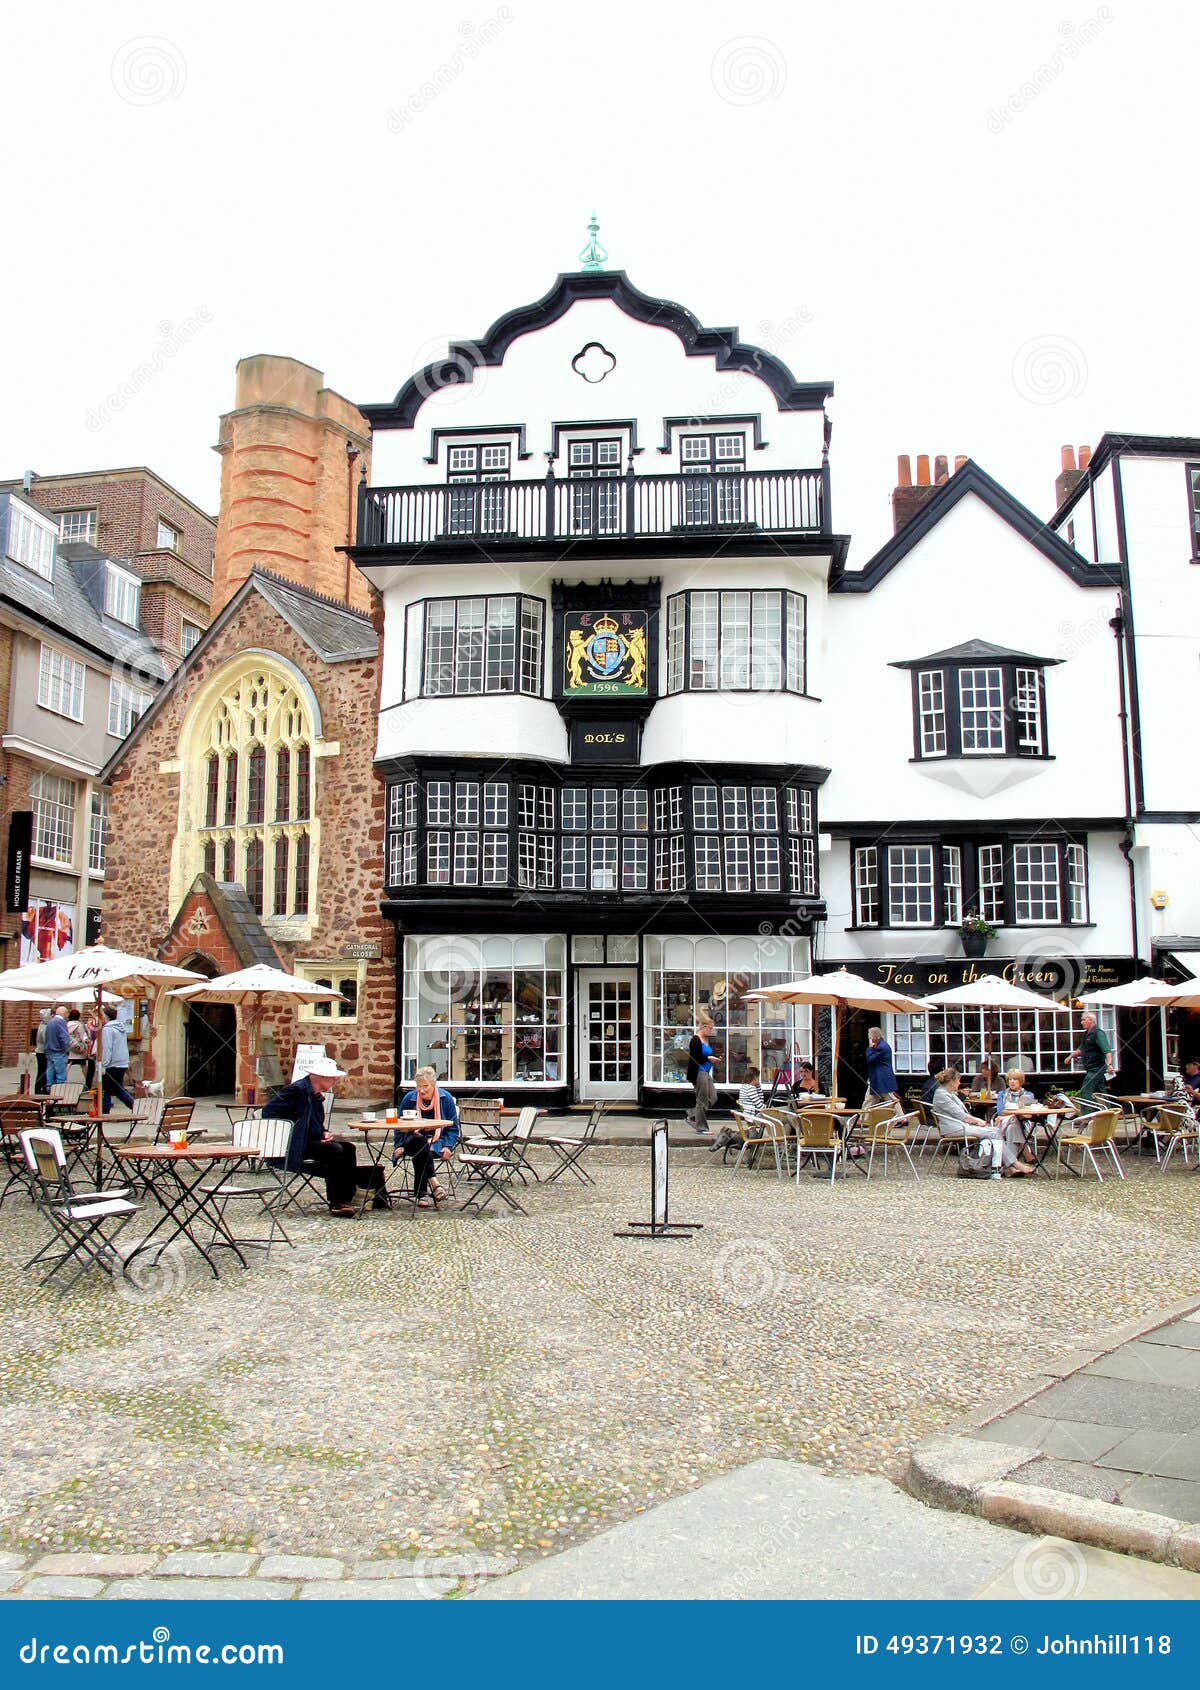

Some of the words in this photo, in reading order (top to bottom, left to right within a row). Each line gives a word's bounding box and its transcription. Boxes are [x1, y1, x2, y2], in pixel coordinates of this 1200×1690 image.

[592, 683, 619, 692] 1596
[584, 733, 625, 743] MOL'S
[15, 850, 23, 873] FRASER
[15, 875, 22, 884] OF
[13, 885, 21, 906] HOUSE
[878, 964, 915, 985] Tea
[928, 975, 949, 984] on
[1002, 962, 1055, 986] Green
